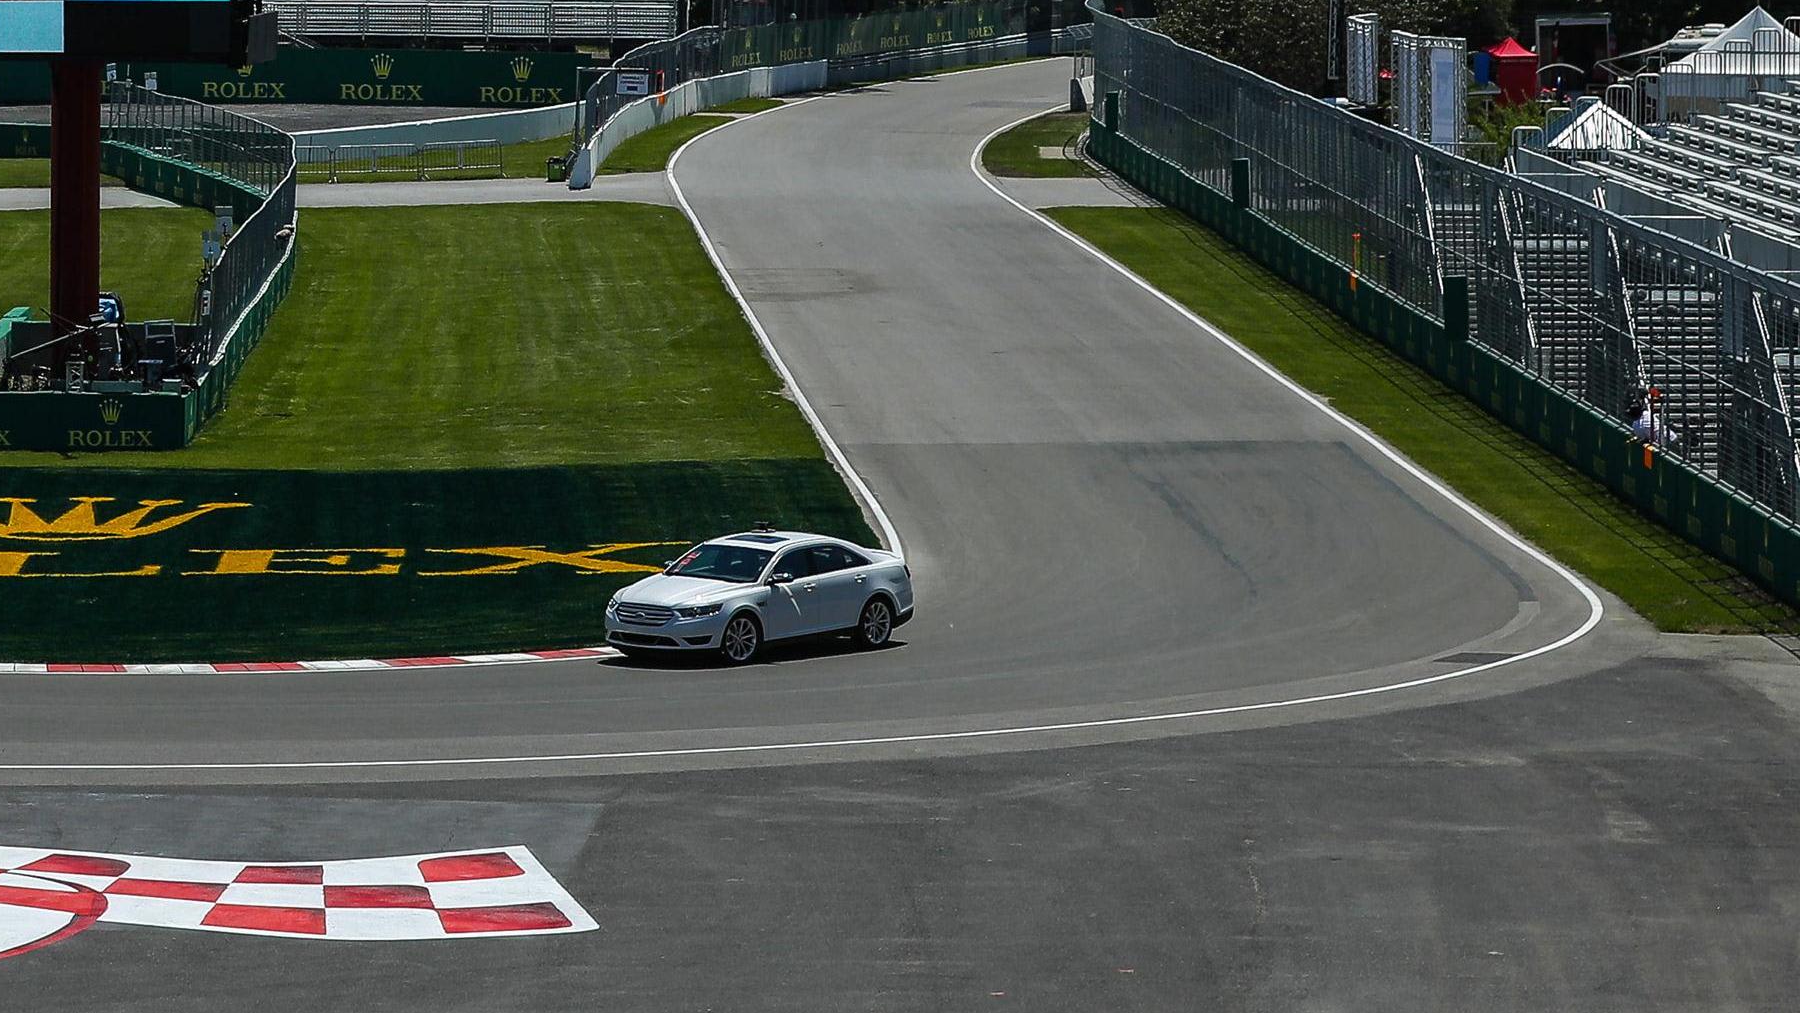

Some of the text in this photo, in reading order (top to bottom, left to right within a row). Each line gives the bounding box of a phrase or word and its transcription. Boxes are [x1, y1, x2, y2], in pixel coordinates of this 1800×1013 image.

[202, 82, 287, 99] ROLEX
[340, 83, 424, 101] ROLEX
[479, 86, 563, 104] ROLEX
[67, 430, 153, 447] ROLEX
